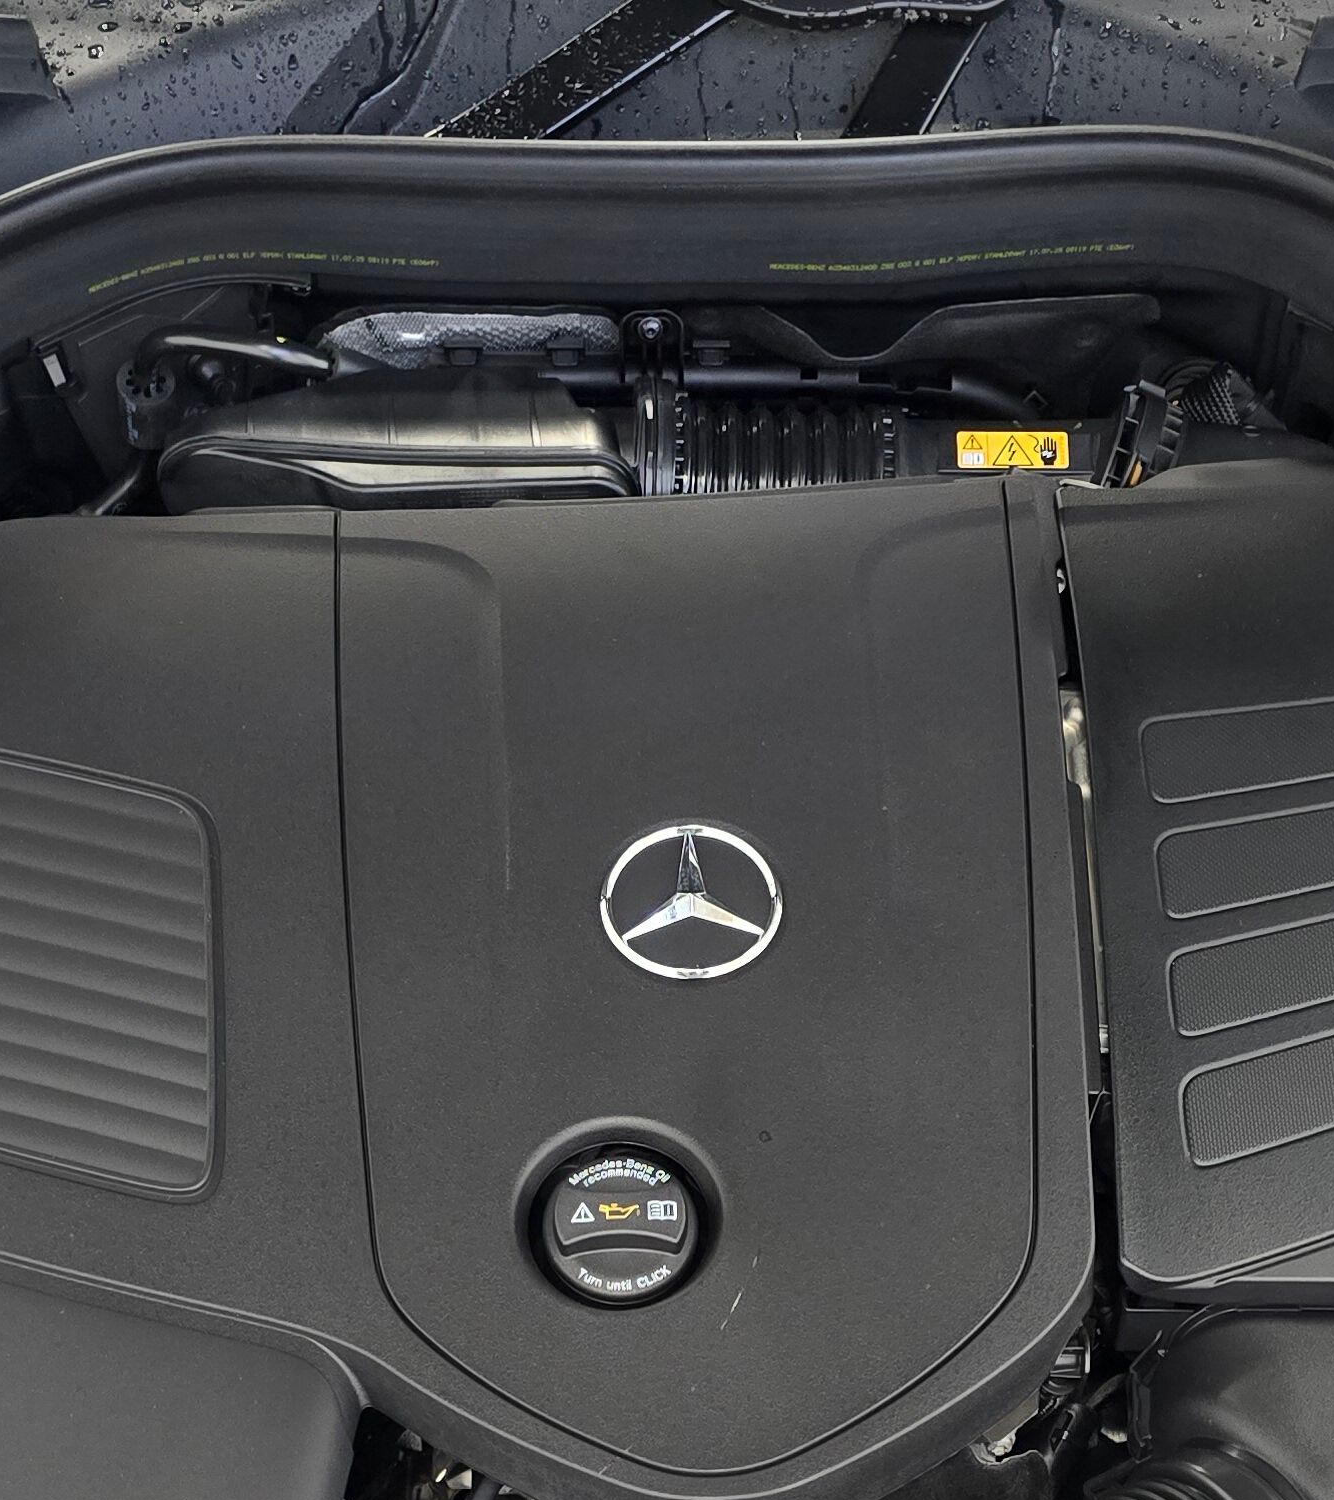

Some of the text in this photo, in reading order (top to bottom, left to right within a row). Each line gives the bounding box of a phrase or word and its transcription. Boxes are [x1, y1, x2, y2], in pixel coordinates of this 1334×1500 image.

[568, 1158, 655, 1186] Mercedes-Benz
[582, 1167, 659, 1188] recommended
[577, 1264, 672, 1292] Turn until CLICK
